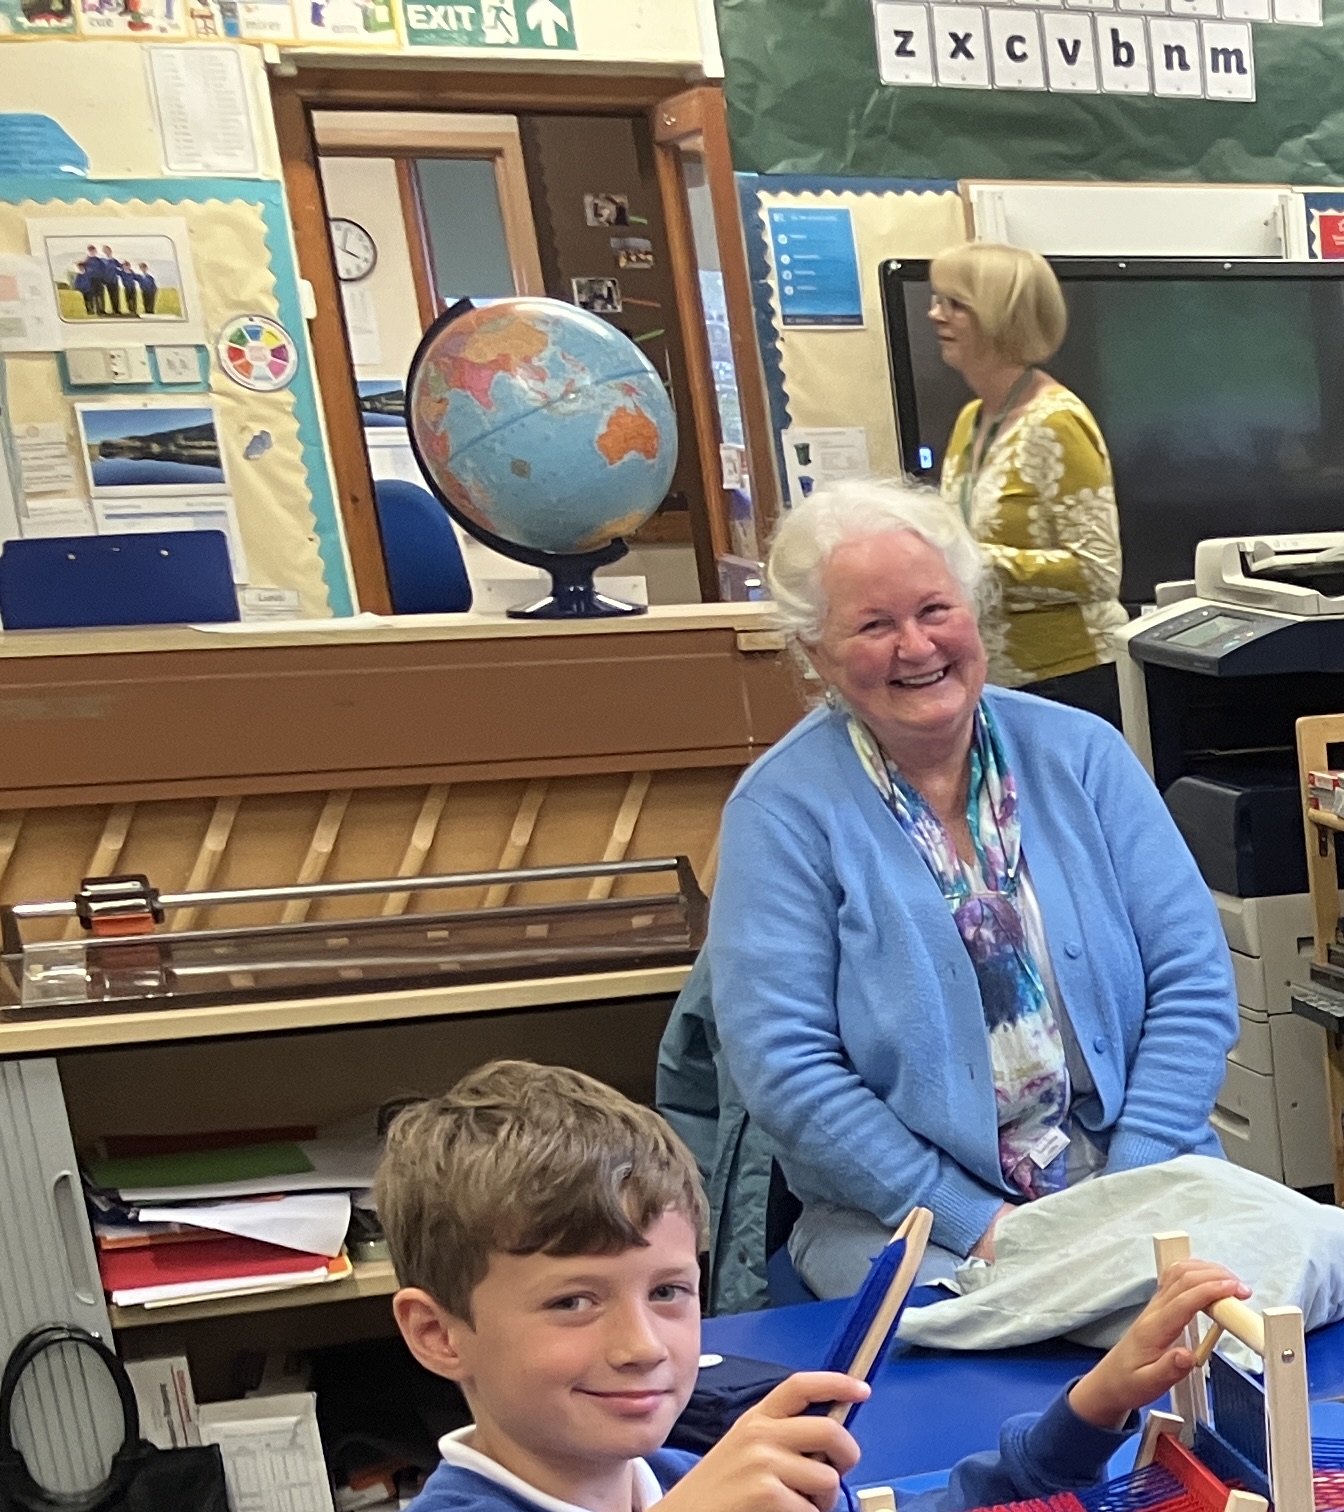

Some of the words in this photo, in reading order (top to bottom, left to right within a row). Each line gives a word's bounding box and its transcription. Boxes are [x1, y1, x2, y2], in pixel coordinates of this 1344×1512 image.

[406, 4, 477, 32] EXIT
[892, 29, 916, 59] z
[947, 31, 975, 61] x
[1004, 33, 1029, 64] c
[1056, 37, 1082, 66] v
[1110, 28, 1135, 68] b
[1163, 43, 1191, 72] n
[1210, 45, 1248, 76] m
